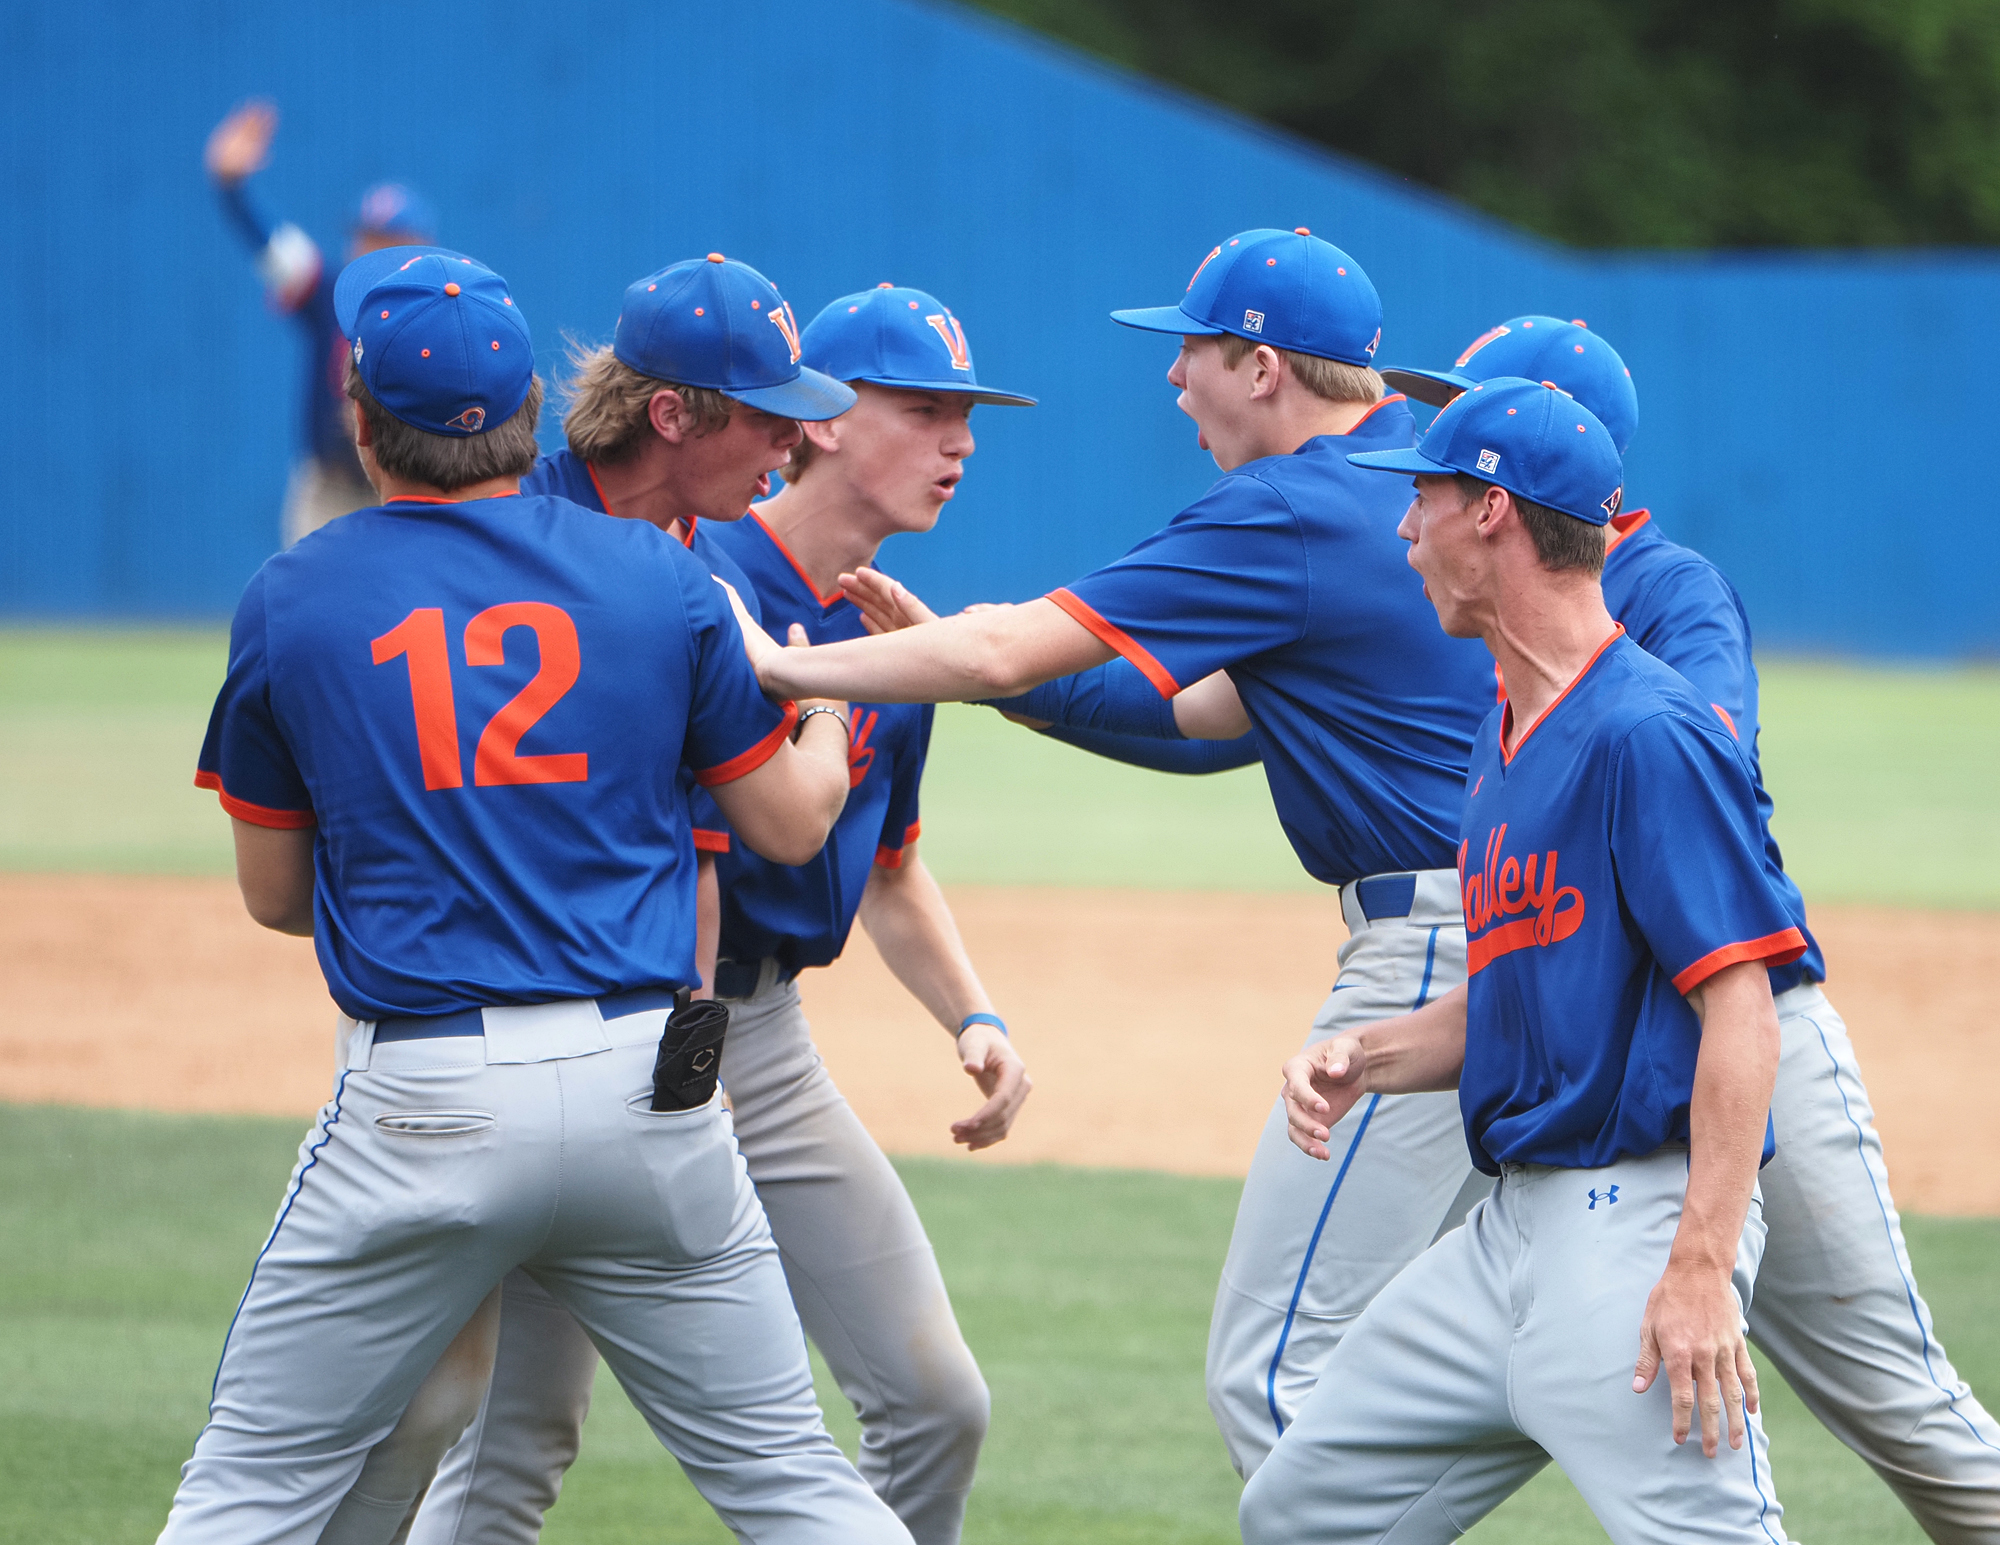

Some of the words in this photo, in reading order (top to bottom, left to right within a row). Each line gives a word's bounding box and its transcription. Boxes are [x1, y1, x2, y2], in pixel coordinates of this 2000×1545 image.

[768, 301, 802, 365] V
[926, 315, 970, 370] V
[370, 601, 588, 791] 12
